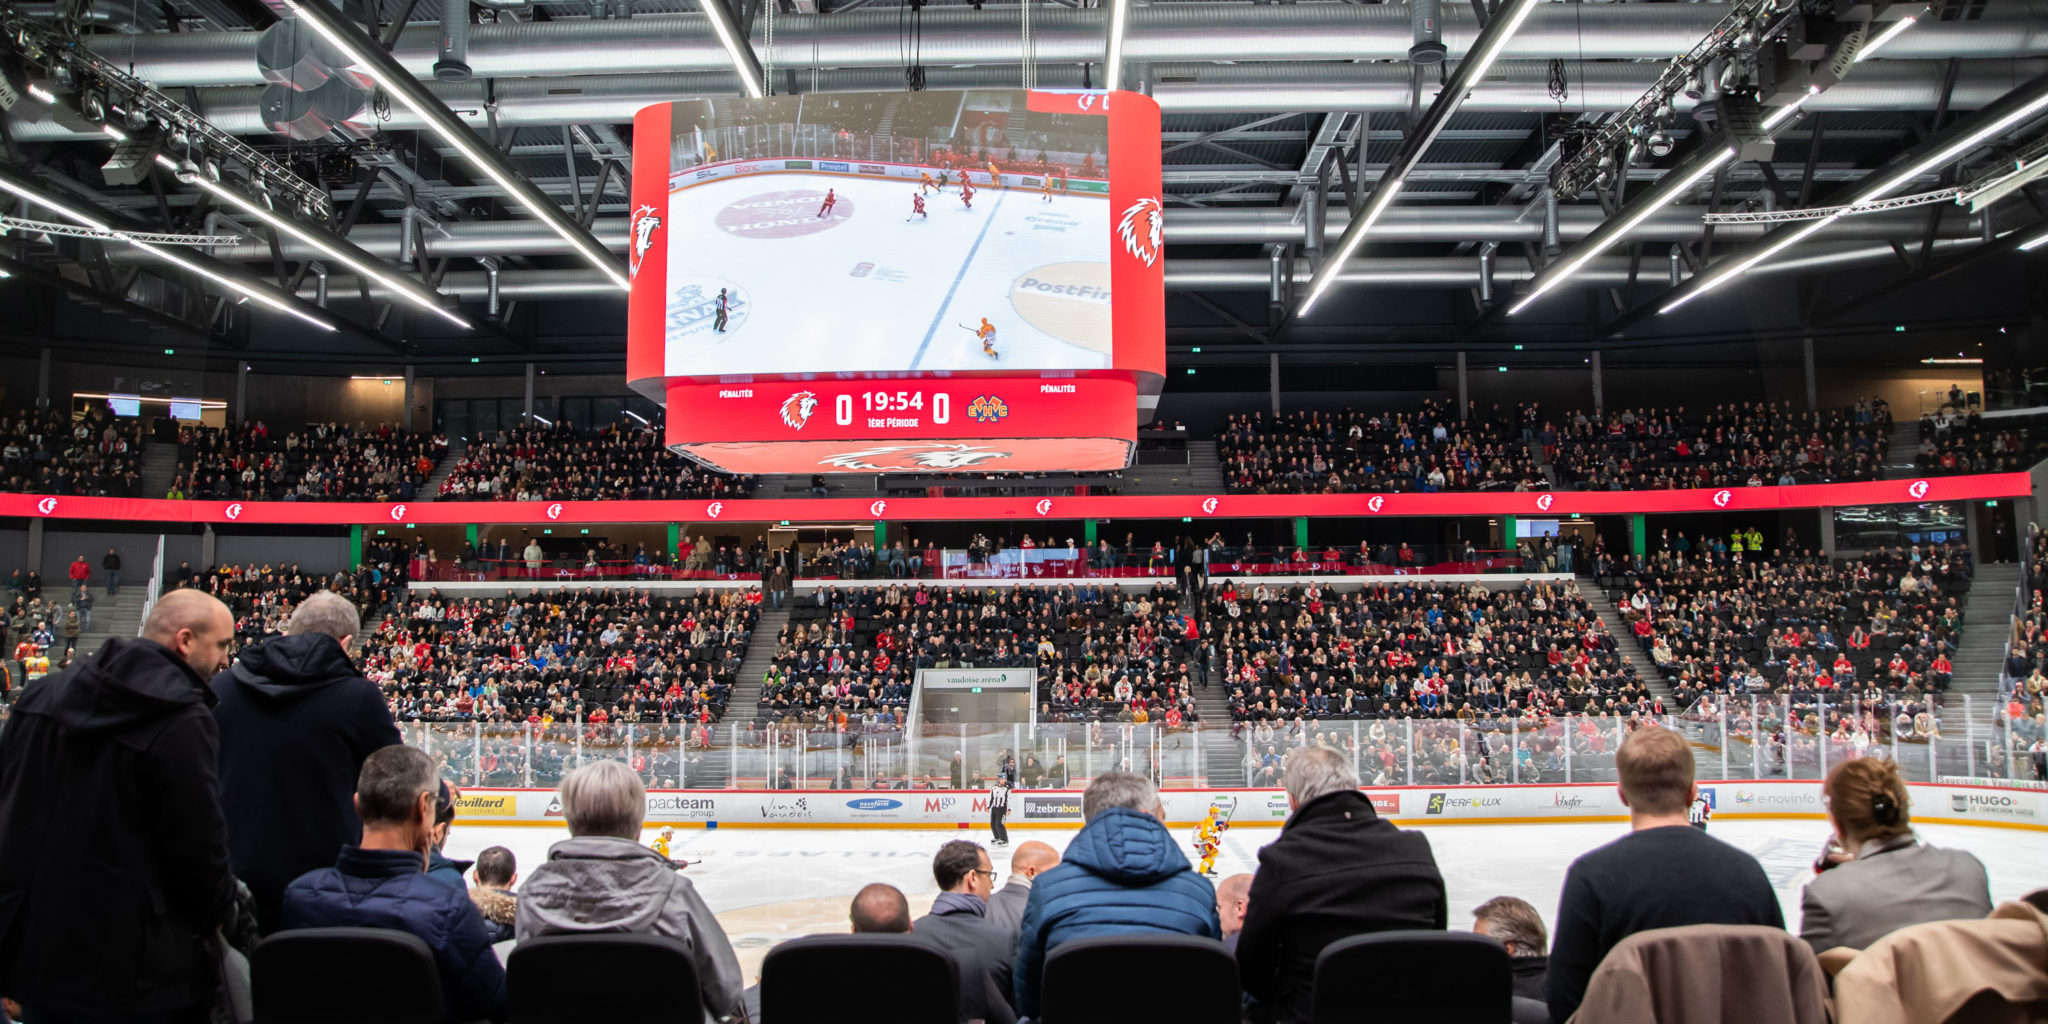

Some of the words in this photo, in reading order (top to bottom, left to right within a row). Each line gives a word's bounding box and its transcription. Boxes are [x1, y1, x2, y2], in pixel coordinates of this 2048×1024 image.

[719, 389, 753, 398] PÉNALITÉS
[1040, 384, 1076, 393] PÉNALITÉS
[862, 391, 923, 411] 19:54
[835, 394, 852, 426] 0
[933, 393, 950, 424] 0
[968, 404, 1008, 418] EHC
[867, 417, 886, 428] 1ÈRE
[887, 416, 919, 428] PÉRIODE
[947, 675, 979, 684] vaudoise
[648, 796, 714, 812] pacteam
[1758, 793, 1815, 804] e-novinfo
[1970, 795, 2011, 806] HUGO
[1036, 802, 1081, 813] zebrabox
[690, 809, 714, 818] group
